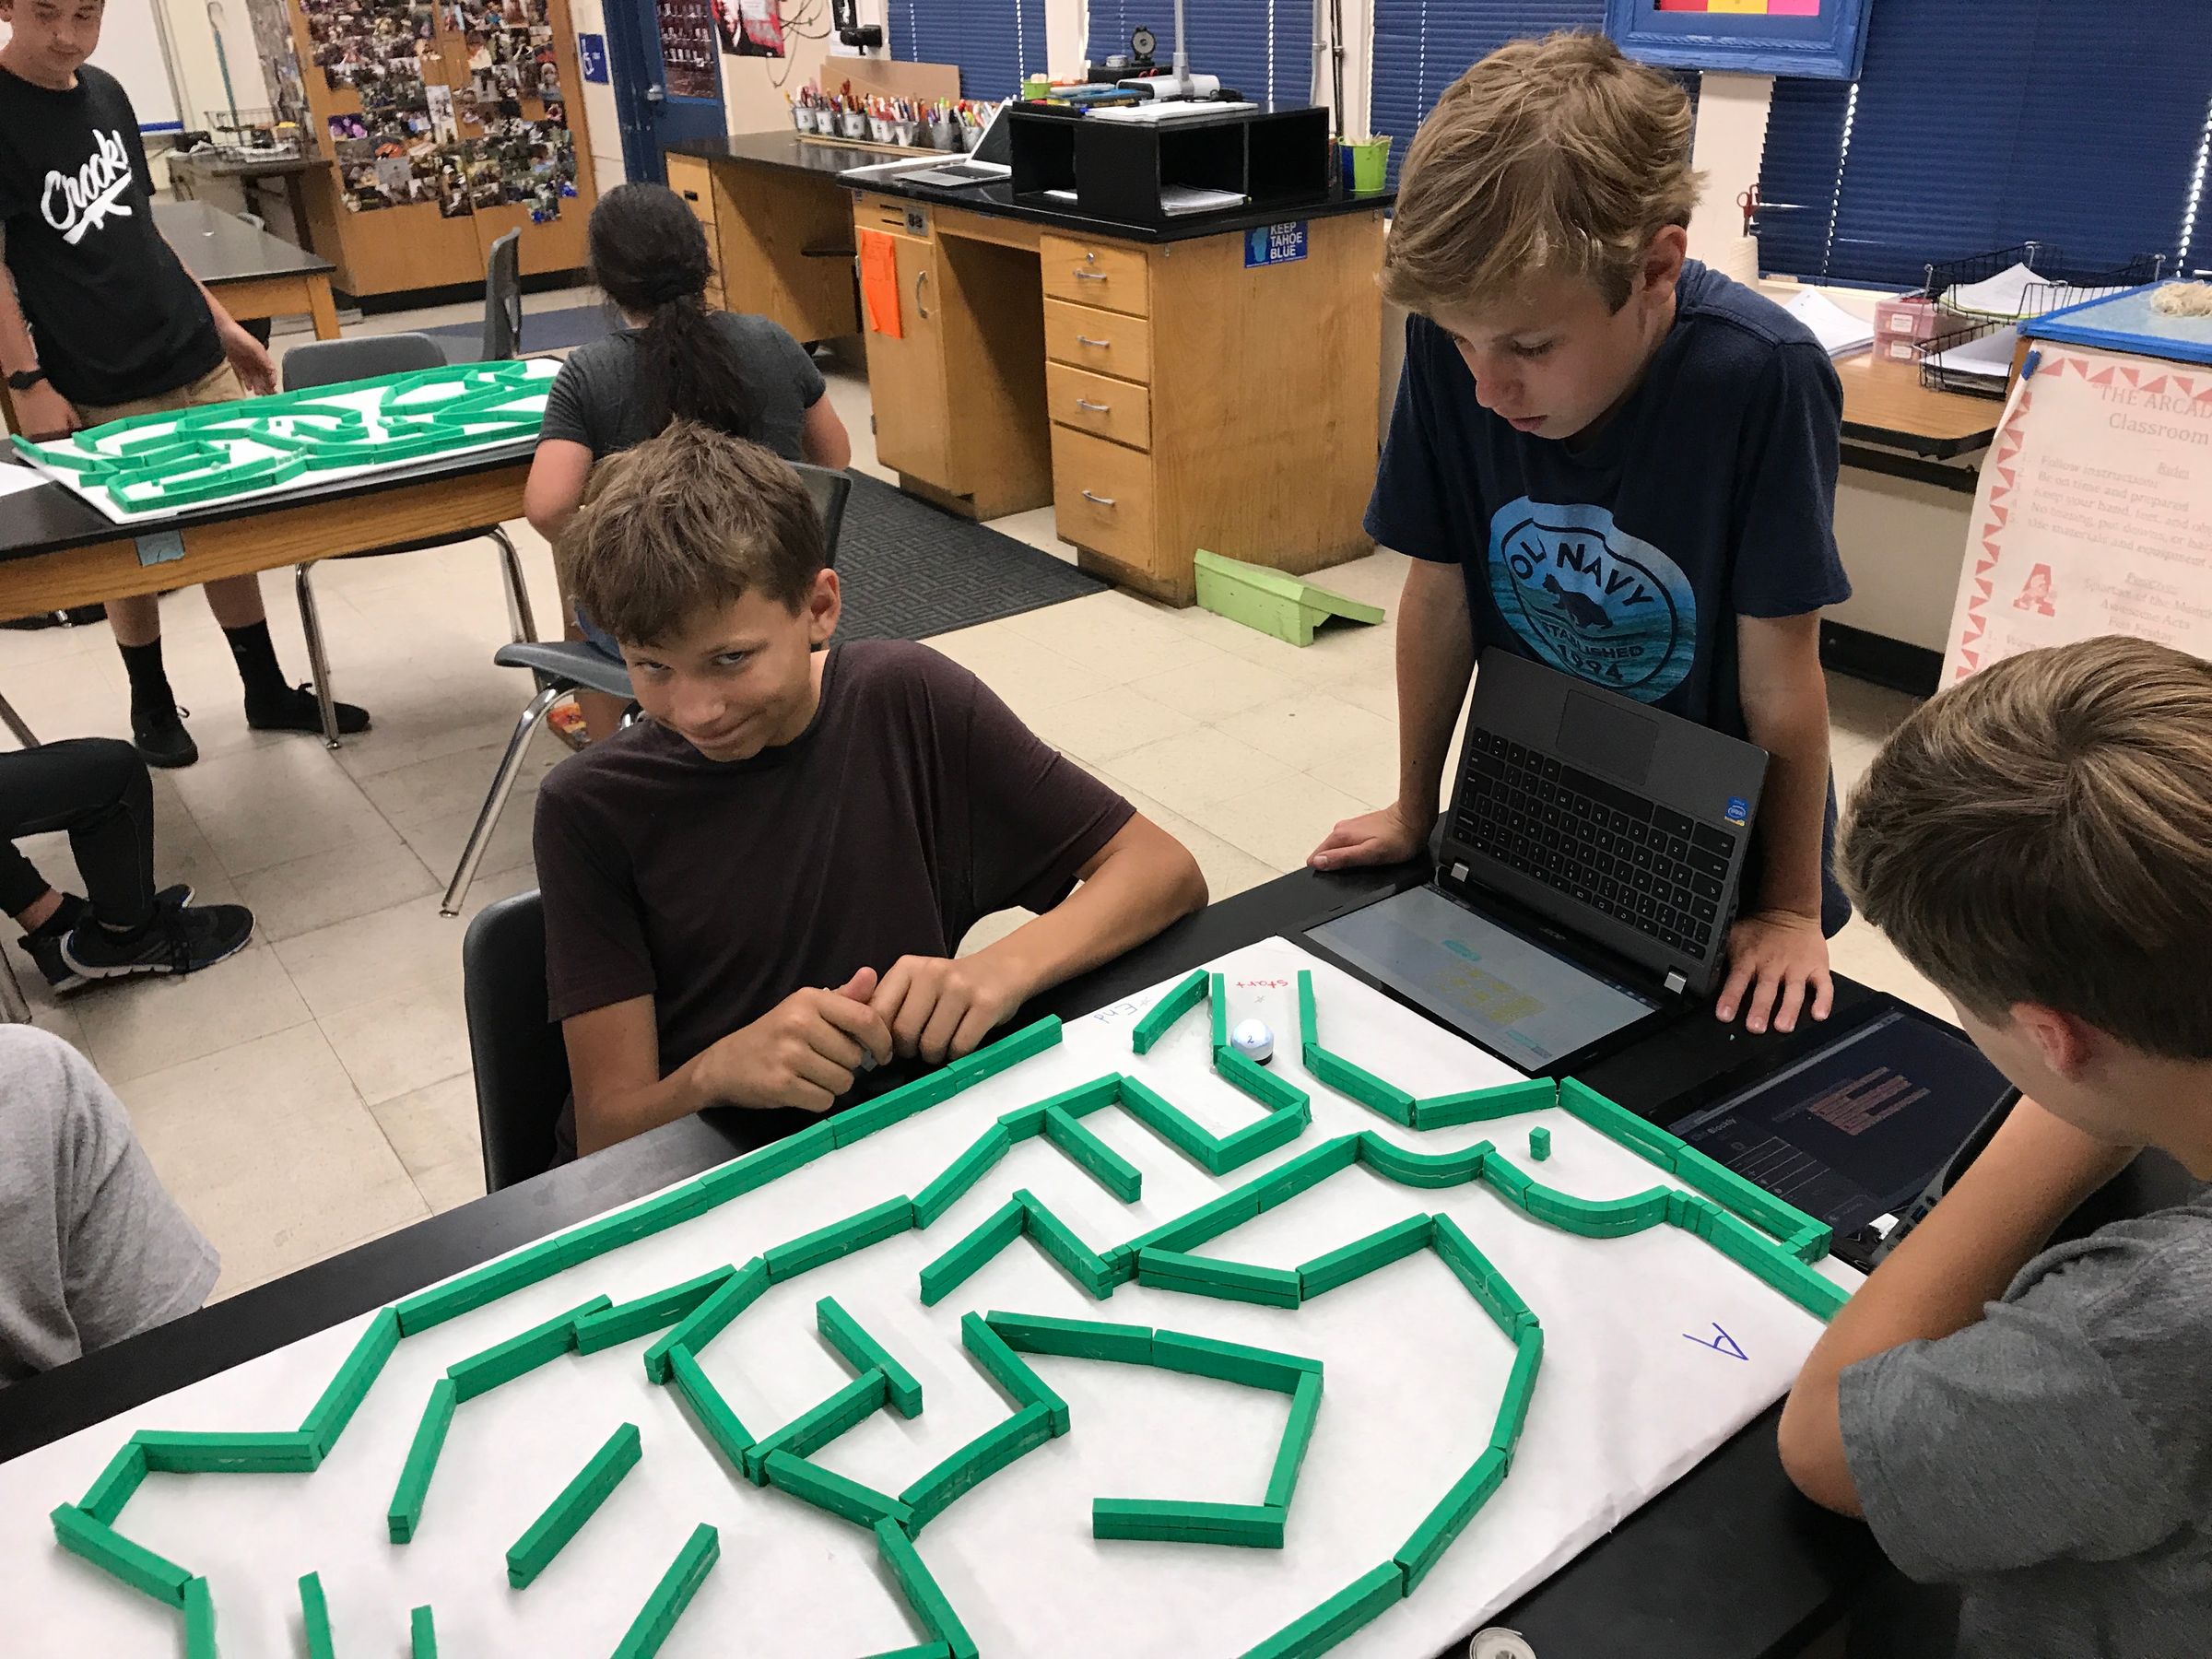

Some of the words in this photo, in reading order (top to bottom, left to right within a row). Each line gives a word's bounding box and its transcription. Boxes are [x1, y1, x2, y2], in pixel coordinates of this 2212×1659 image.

[1270, 221, 1297, 235] KEEP
[1270, 232, 1303, 247] TAHOE
[1270, 245, 1297, 259] BLUE
[2109, 412, 2209, 445] Classroom
[1510, 533, 1547, 580] OL
[1557, 542, 1655, 606] NAVY
[1558, 644, 1624, 679] 1994
[1093, 1003, 1138, 1024] End
[1247, 1035, 1254, 1044] 2
[1707, 1118, 1736, 1134] Blockly
[1682, 1322, 1749, 1361] A
